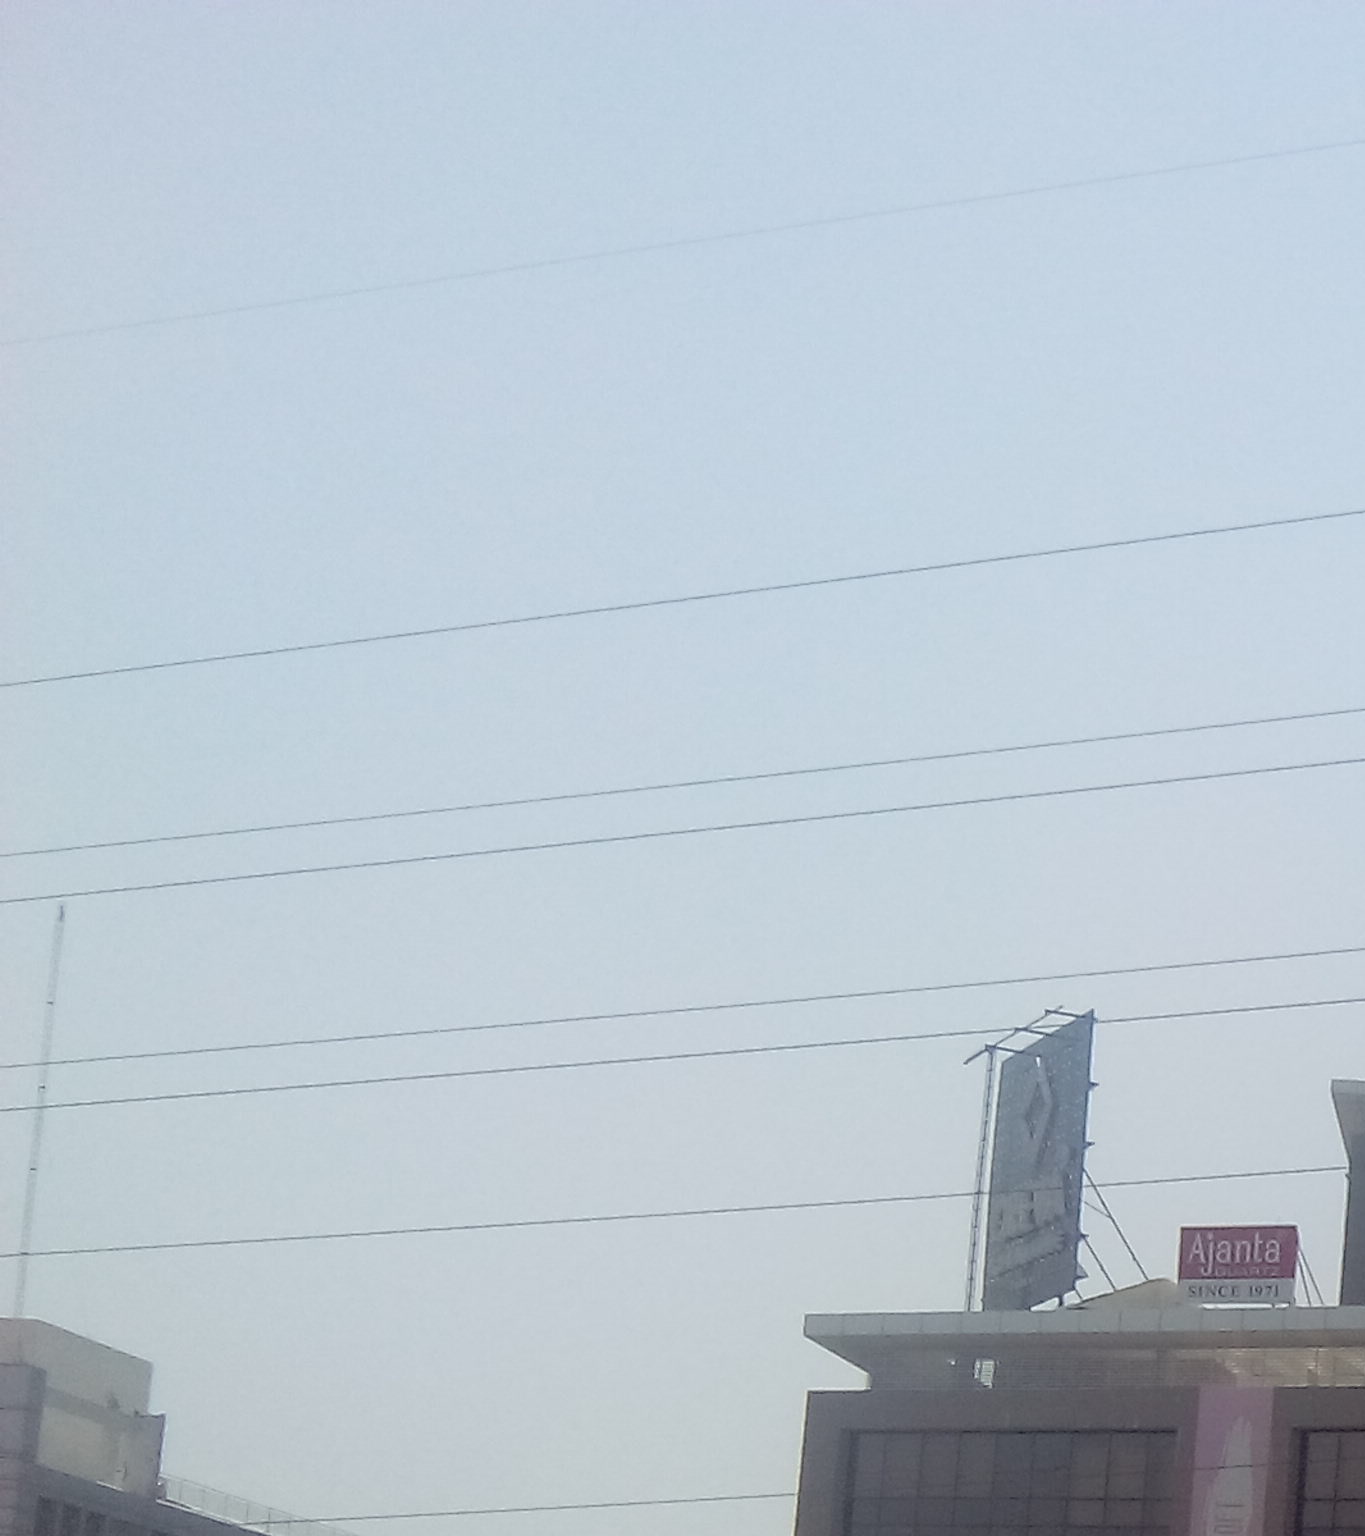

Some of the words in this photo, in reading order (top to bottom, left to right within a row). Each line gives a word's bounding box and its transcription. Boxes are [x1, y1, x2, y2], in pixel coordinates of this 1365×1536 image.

[1188, 1231, 1281, 1276] Ajanta
[1188, 1285, 1240, 1297] SINCE
[1249, 1285, 1279, 1297] 1971
